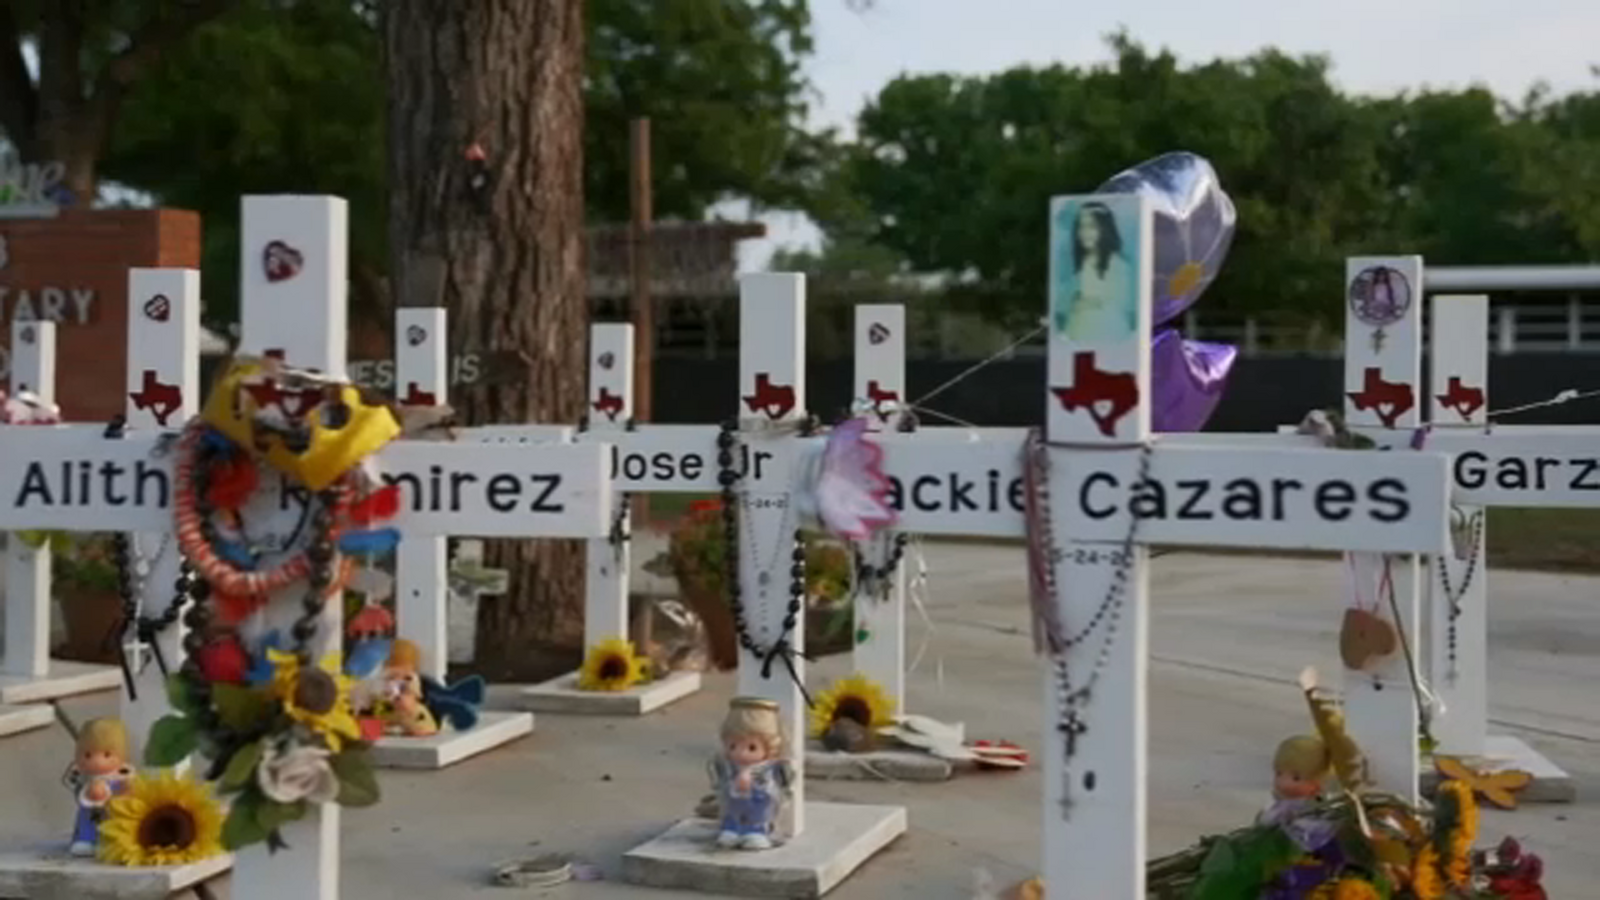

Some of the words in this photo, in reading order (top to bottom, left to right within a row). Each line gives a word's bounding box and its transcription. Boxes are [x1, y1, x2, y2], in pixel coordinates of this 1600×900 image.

[15, 461, 170, 507] Alith
[611, 445, 704, 480] Jose
[884, 469, 1027, 513] ackie
[1078, 471, 1411, 523] Cazares
